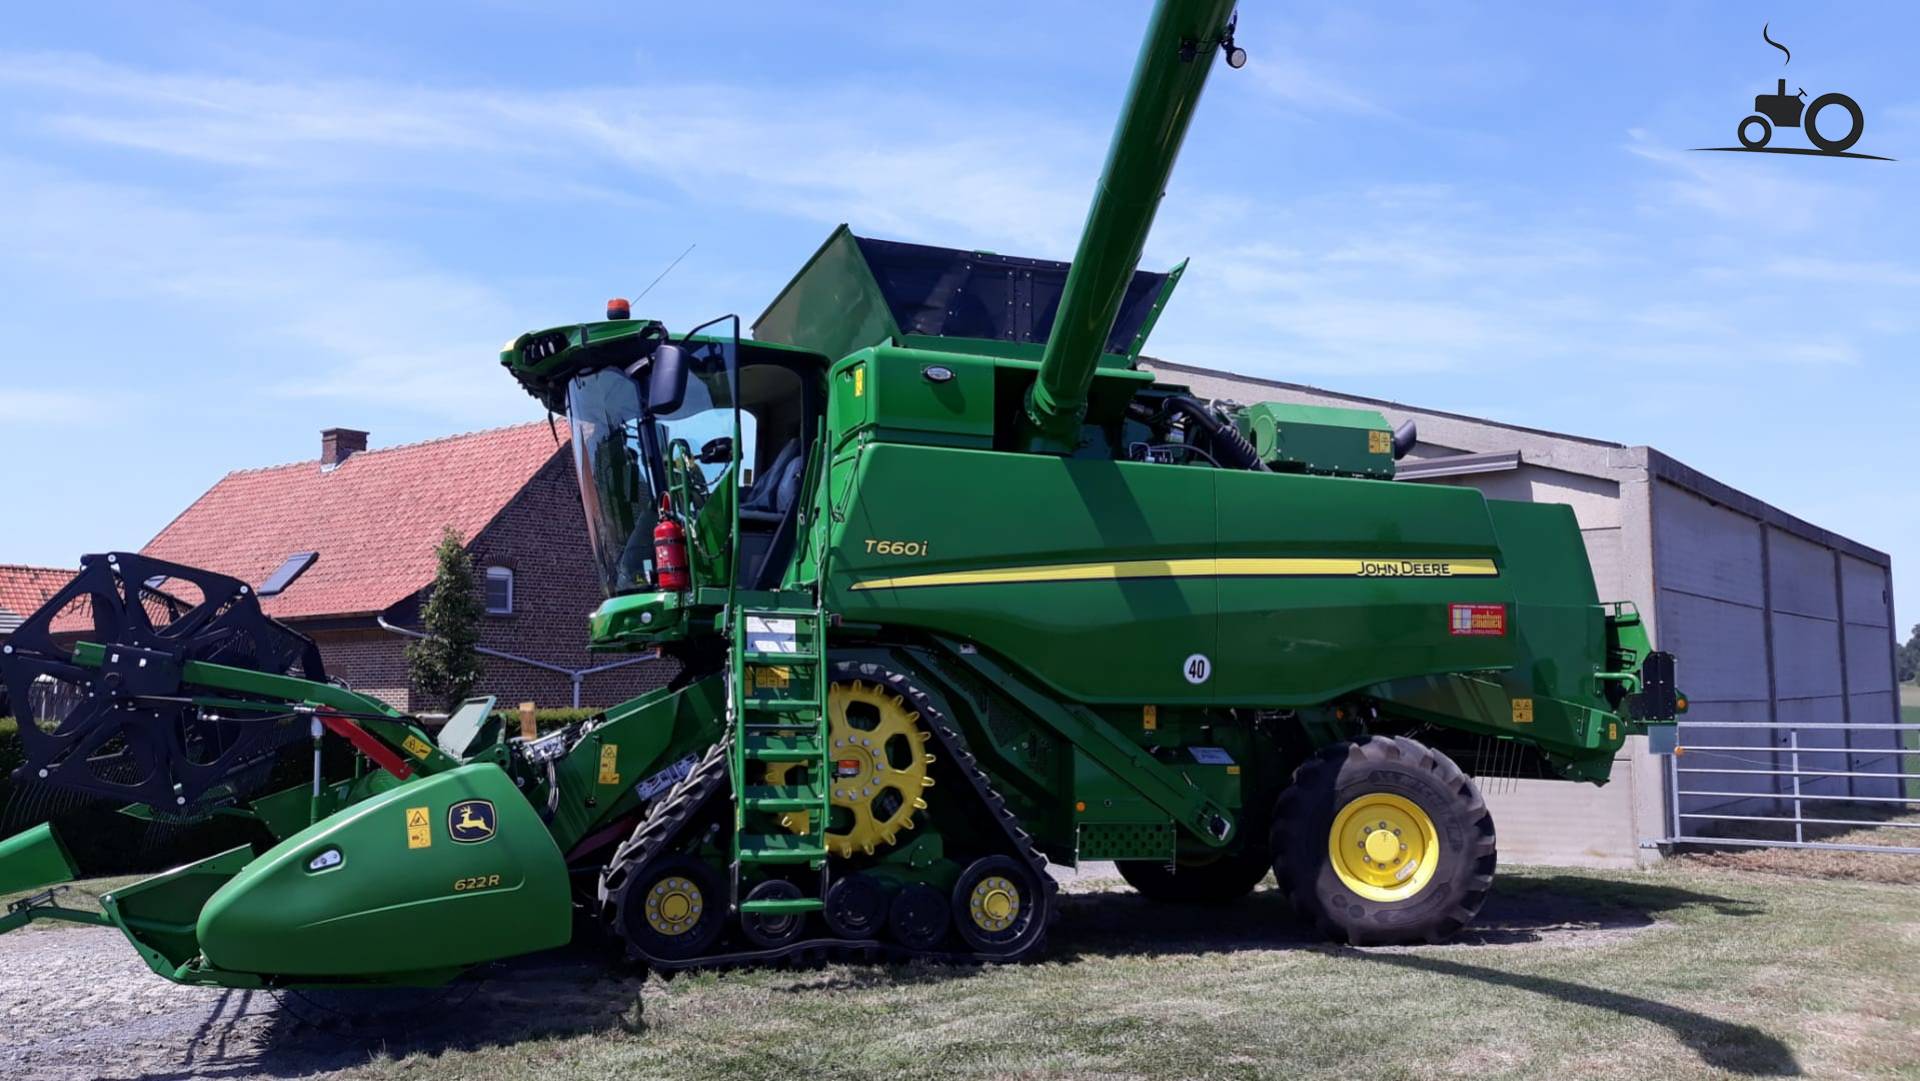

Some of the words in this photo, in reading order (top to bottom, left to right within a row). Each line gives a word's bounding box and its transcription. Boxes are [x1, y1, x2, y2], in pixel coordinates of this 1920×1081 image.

[864, 539, 929, 556] T660i
[1358, 561, 1399, 575] JOHN
[1401, 561, 1450, 575] DEERE
[1188, 659, 1205, 679] 40
[454, 874, 500, 891] 622R
